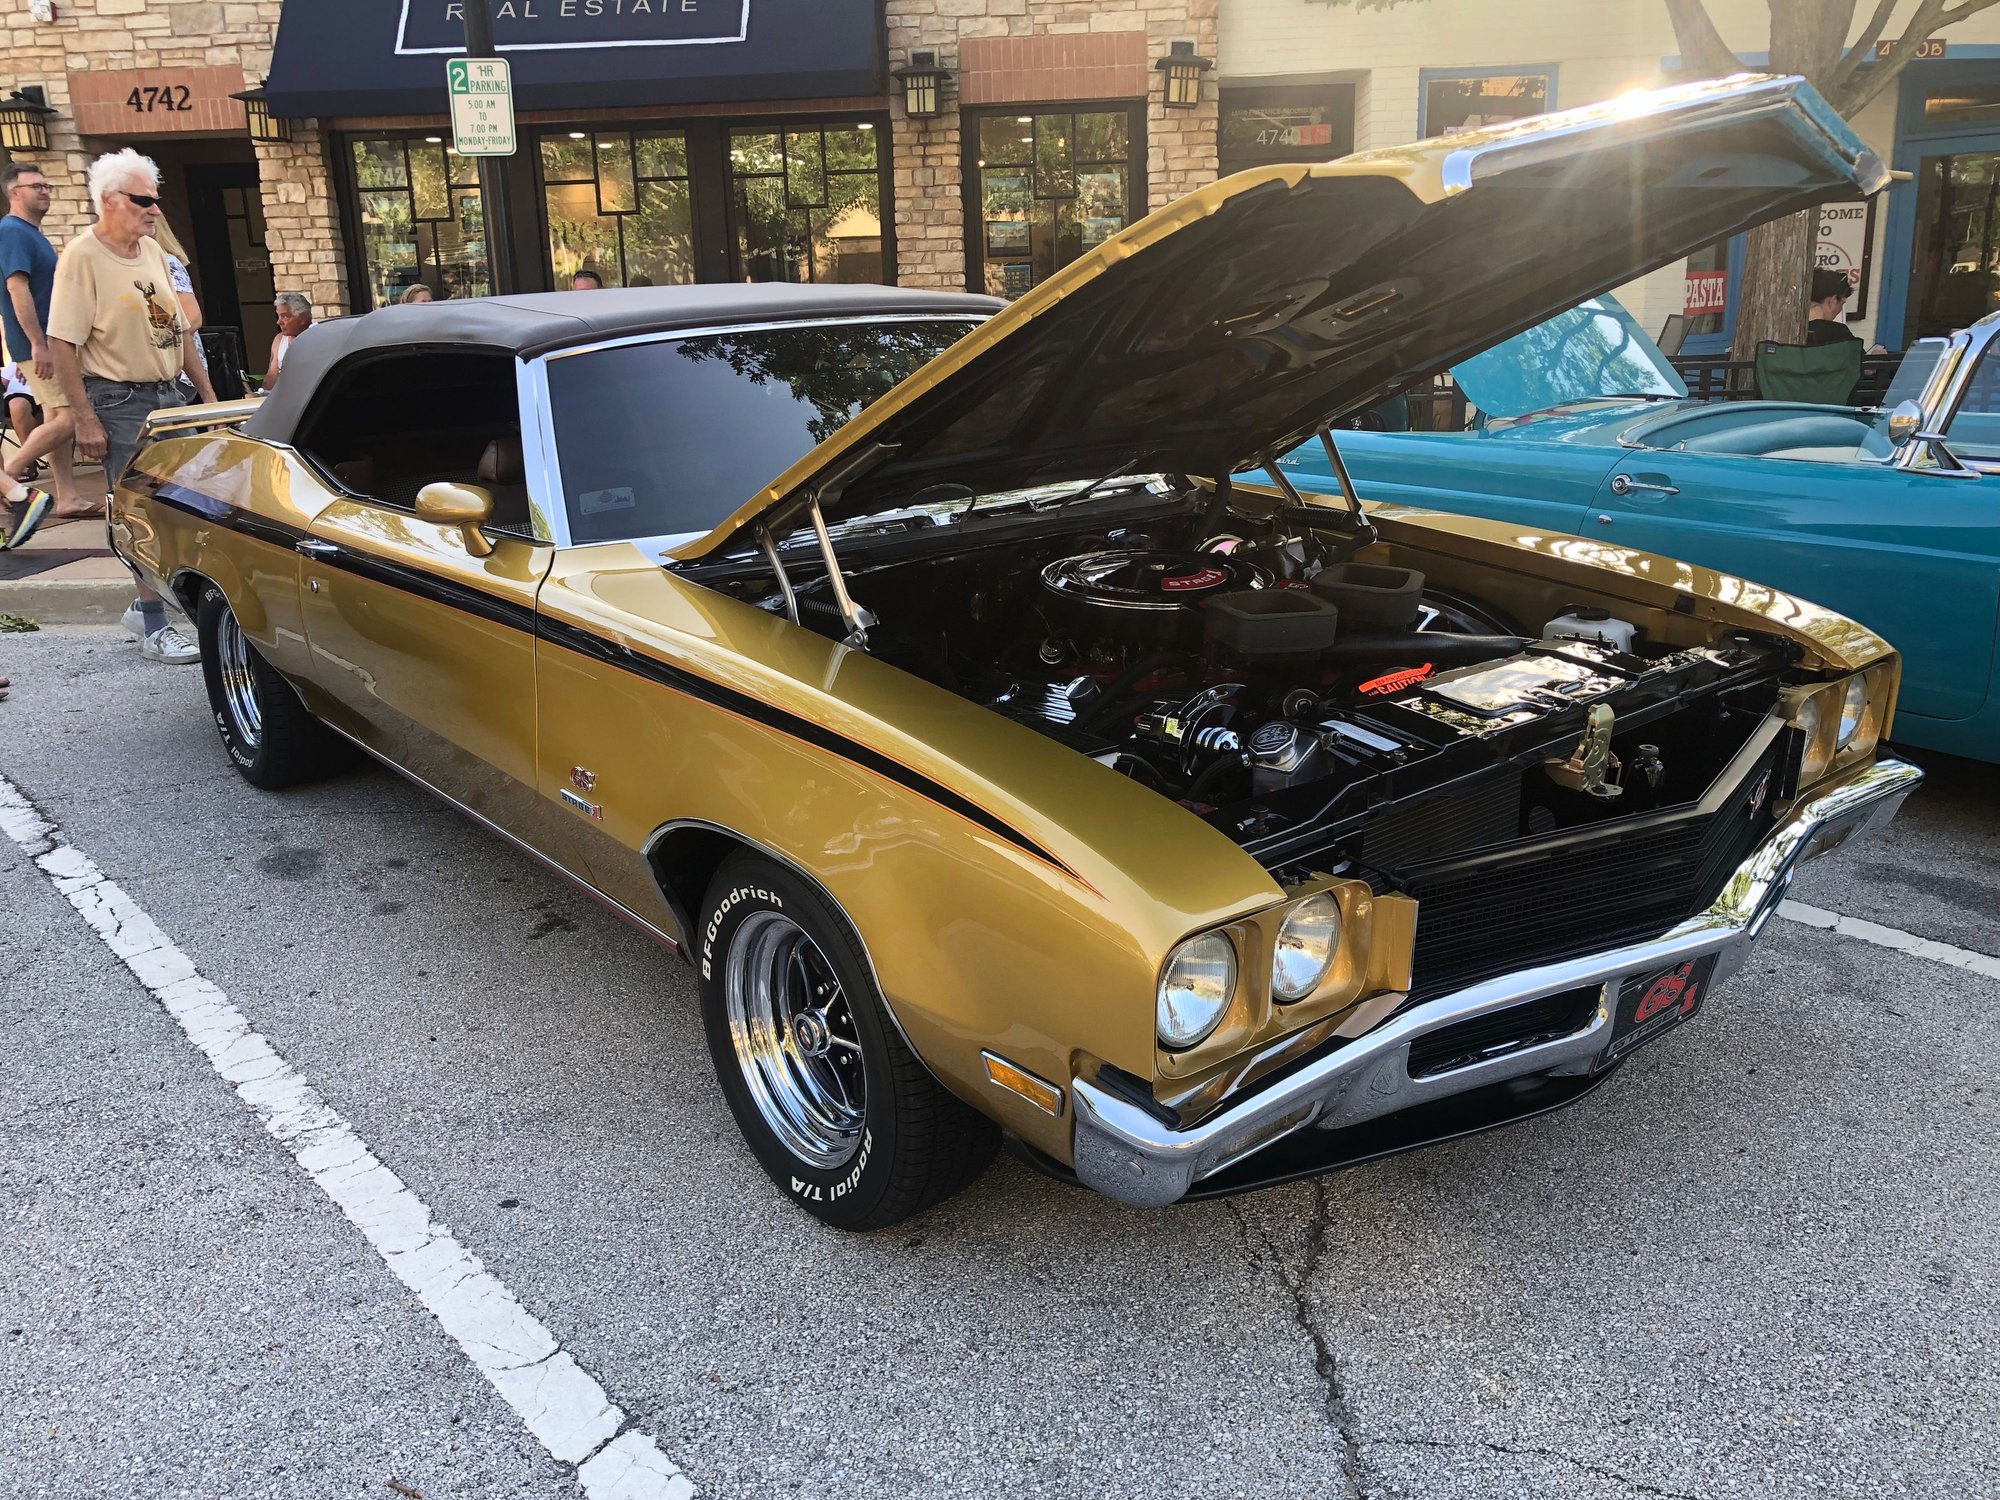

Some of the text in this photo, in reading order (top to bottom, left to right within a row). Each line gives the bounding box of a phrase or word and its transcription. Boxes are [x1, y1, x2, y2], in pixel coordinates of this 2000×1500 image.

[445, 1, 538, 20] RAL
[453, 65, 494, 91] 2 HR
[470, 80, 507, 92] PARKING
[127, 84, 192, 112] 4742
[486, 99, 496, 109] AM
[478, 111, 488, 121] TO
[488, 124, 498, 133] PM
[458, 135, 511, 146] MONDAY-FRIDAY
[1820, 208, 1864, 220] COME
[1684, 278, 1724, 308] PASTA
[1378, 675, 1426, 694] CAUTION
[561, 791, 592, 816] STAGE
[702, 885, 783, 981] BFGoodrich
[1634, 959, 1697, 1023] GS
[791, 1127, 873, 1201] Radial T/A
